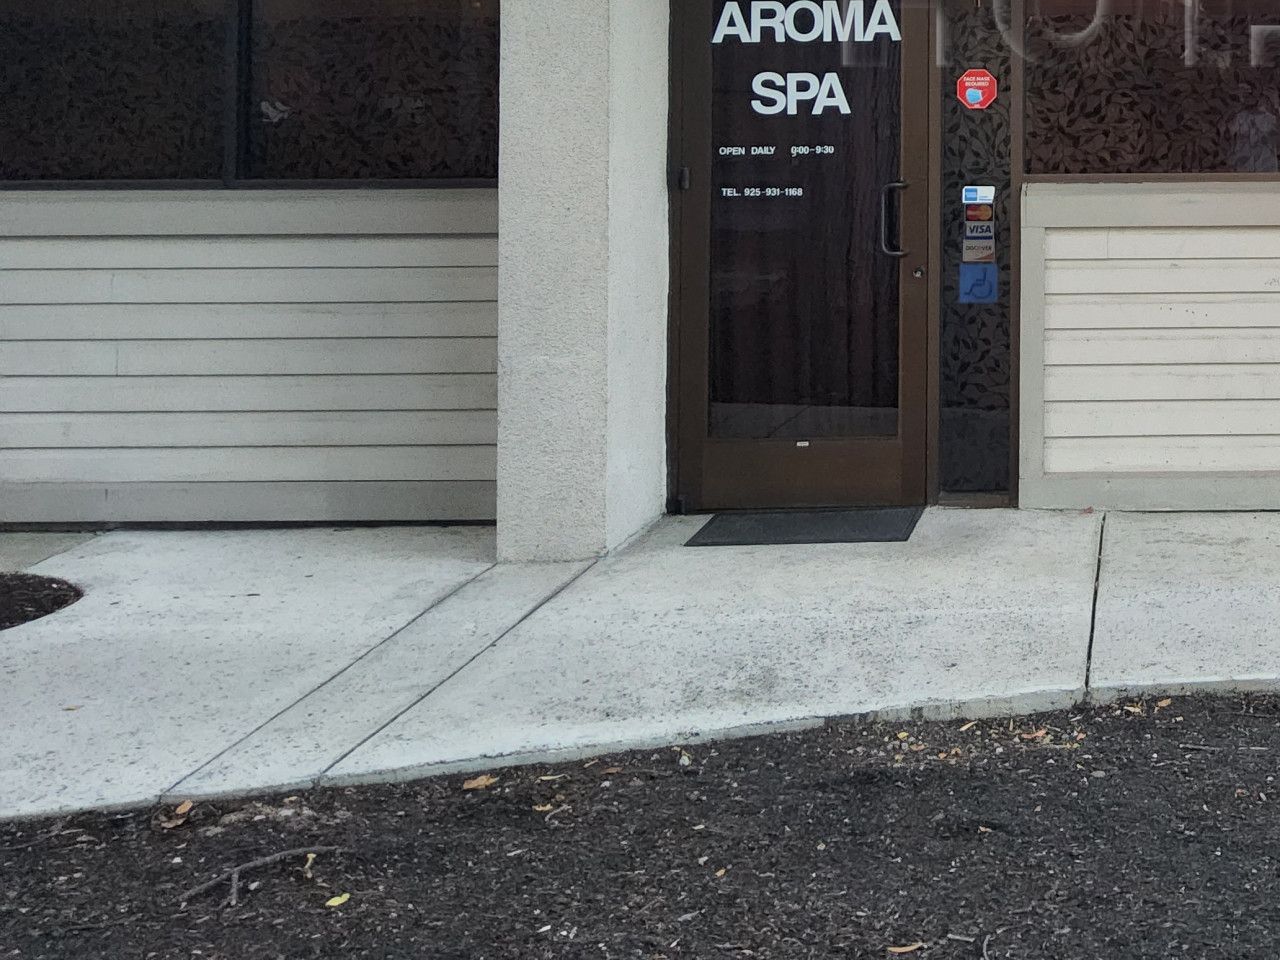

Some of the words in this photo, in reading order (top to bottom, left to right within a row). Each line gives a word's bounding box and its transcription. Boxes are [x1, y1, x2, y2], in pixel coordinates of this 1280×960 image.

[711, 0, 903, 43] AROMA
[750, 71, 852, 116] SPA
[719, 146, 746, 155] OPEN
[751, 146, 776, 155] DAILY
[721, 187, 742, 197] TEL.
[744, 187, 803, 197] 925-931-1168
[969, 224, 992, 234] VISA
